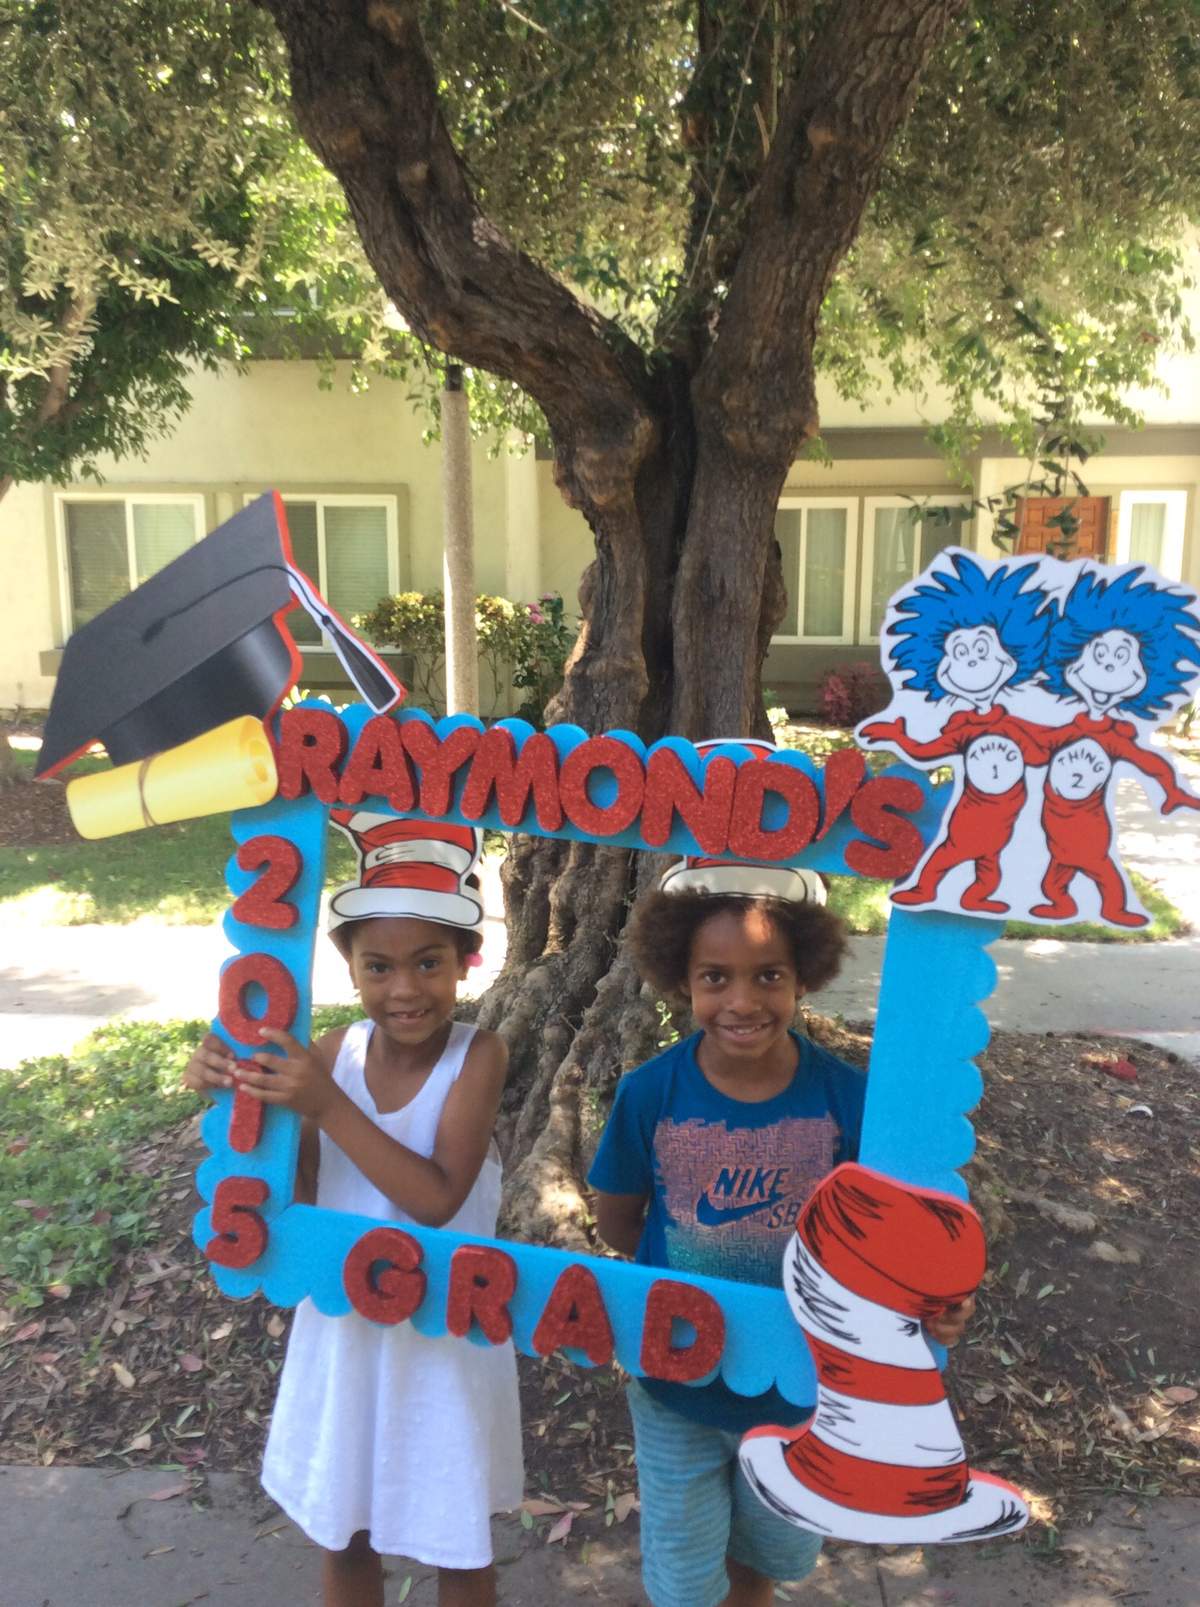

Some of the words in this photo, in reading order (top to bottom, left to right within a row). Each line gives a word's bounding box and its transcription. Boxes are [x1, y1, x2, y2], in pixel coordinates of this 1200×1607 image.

[970, 742, 1017, 761] THING
[1057, 748, 1105, 773] THING
[991, 765, 999, 779] 1
[1071, 773, 1084, 788] 2
[277, 706, 925, 879] RAYMOND'S
[712, 1167, 790, 1200] NIKE
[767, 1203, 801, 1229] SB
[343, 1227, 726, 1383] GRAD
